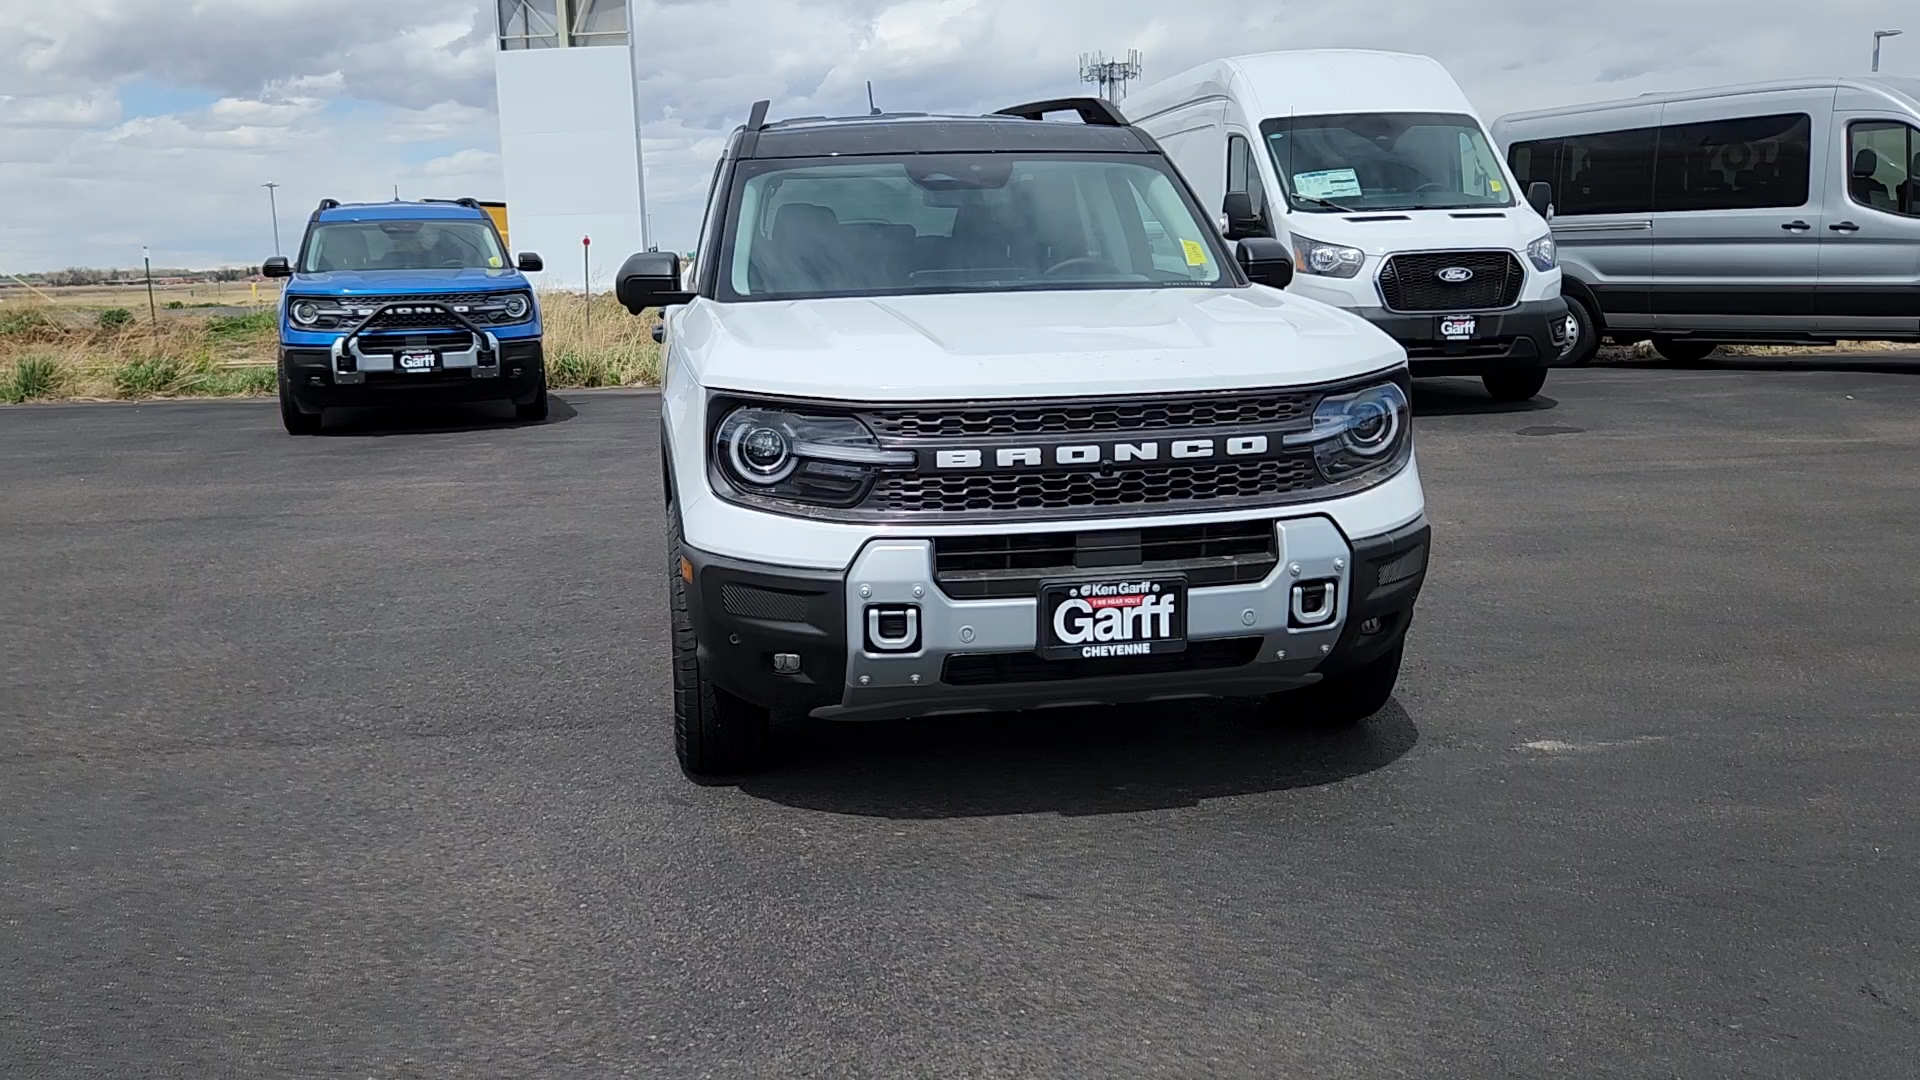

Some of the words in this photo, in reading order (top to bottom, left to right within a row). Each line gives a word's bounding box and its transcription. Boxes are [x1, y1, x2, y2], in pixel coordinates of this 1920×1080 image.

[1440, 320, 1476, 335] Garff
[936, 435, 1268, 468] BRONCO
[1092, 583, 1117, 596] Ken
[1118, 581, 1151, 595] Garff
[1053, 594, 1175, 644] Garff
[1082, 643, 1151, 658] CHEYENNE
